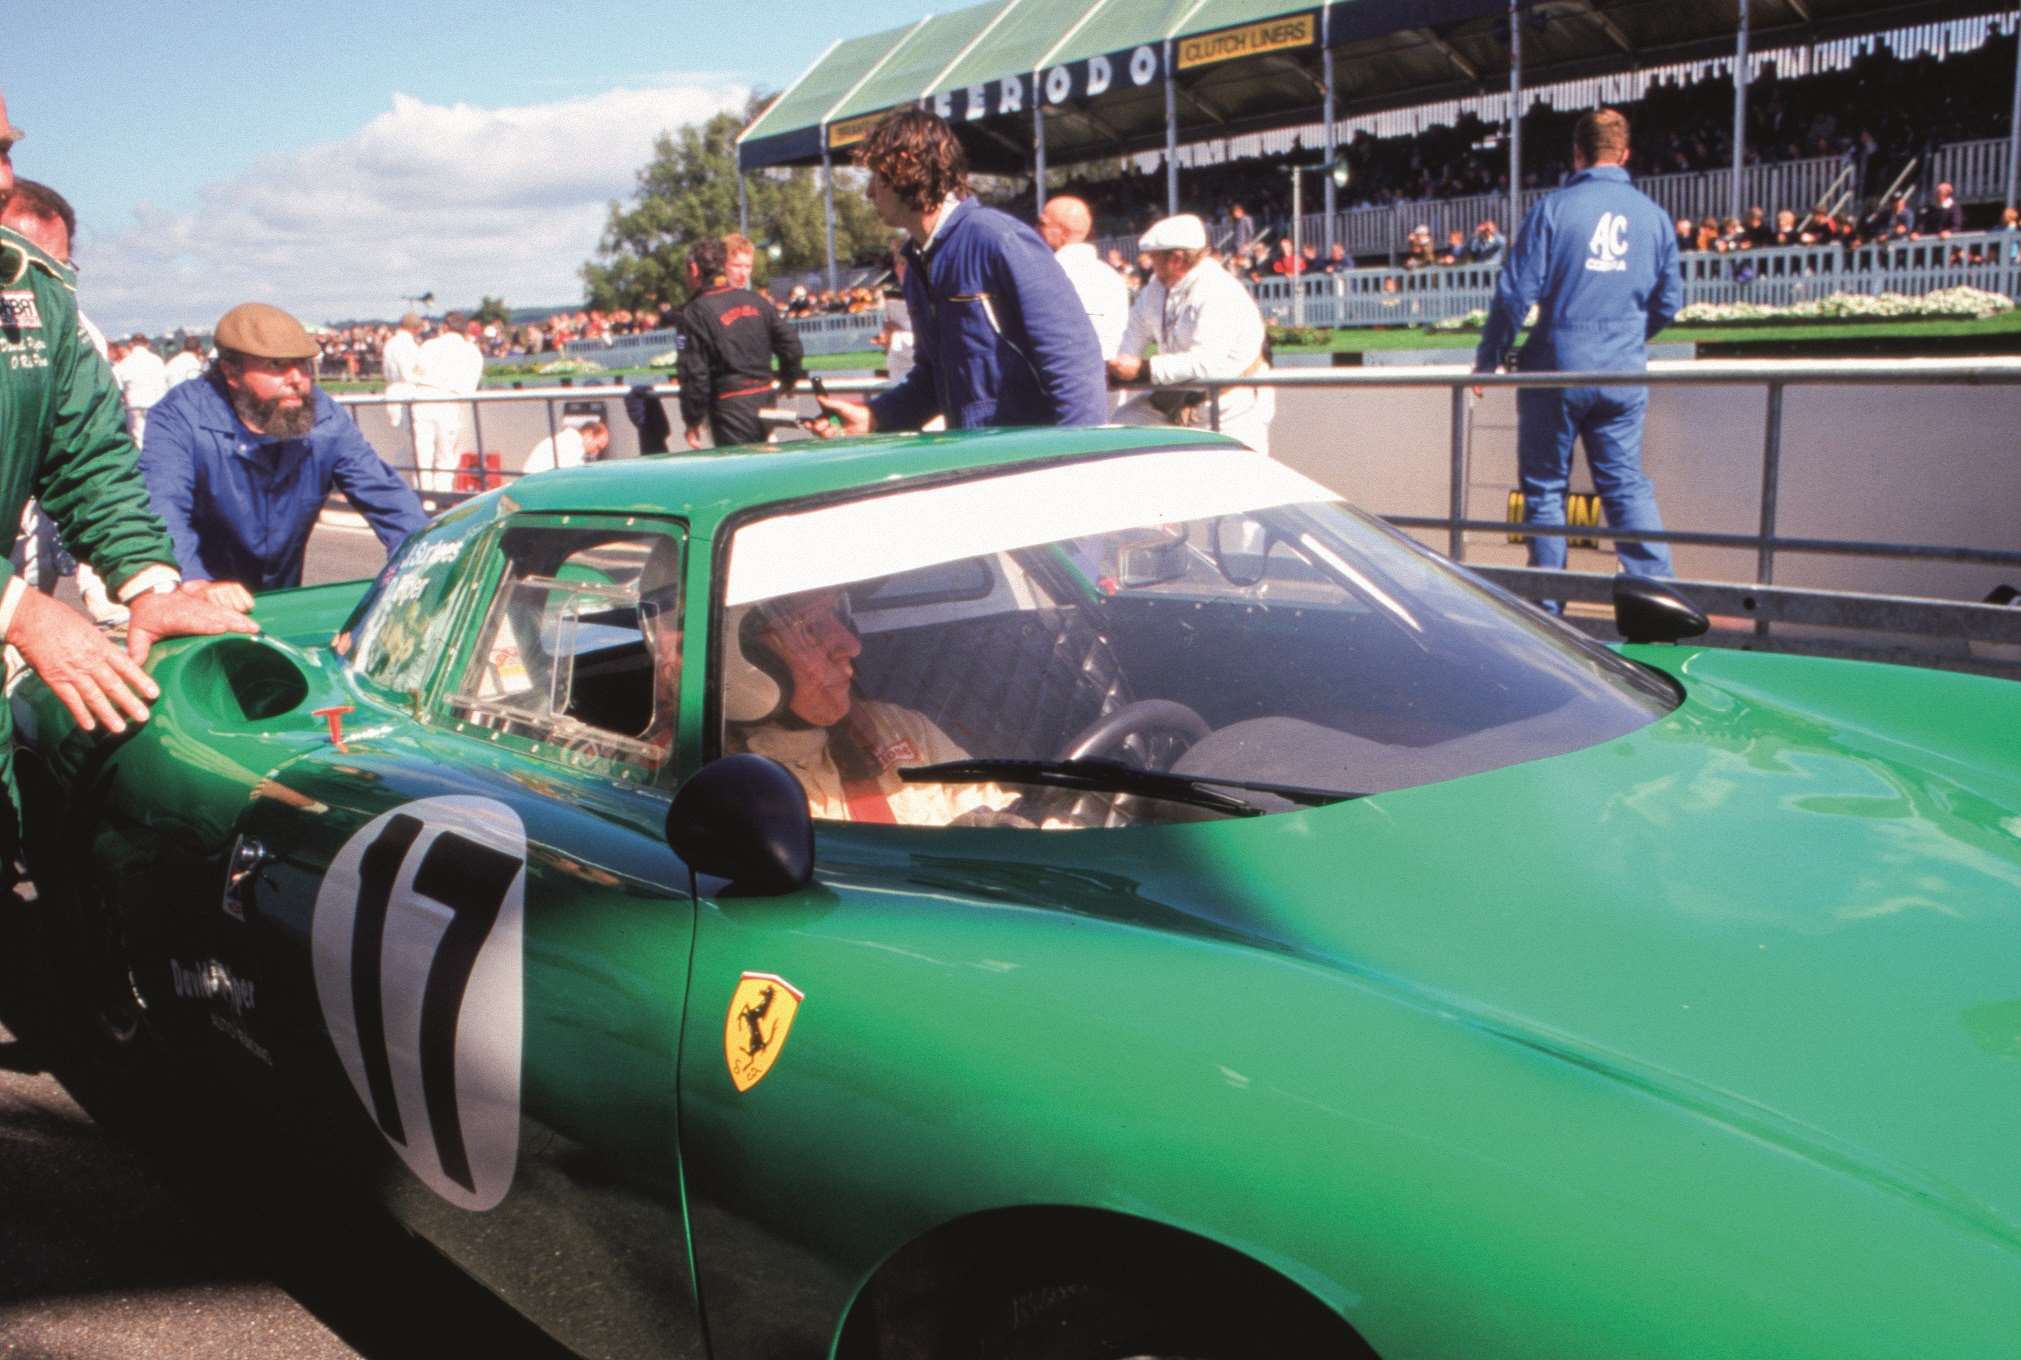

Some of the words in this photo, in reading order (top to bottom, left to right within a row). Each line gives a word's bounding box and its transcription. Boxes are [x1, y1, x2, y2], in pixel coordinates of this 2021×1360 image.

[1184, 31, 1246, 61] CLUTCH
[1250, 21, 1305, 49] LINERS
[1590, 211, 1629, 260] AC
[351, 812, 524, 1195] 17
